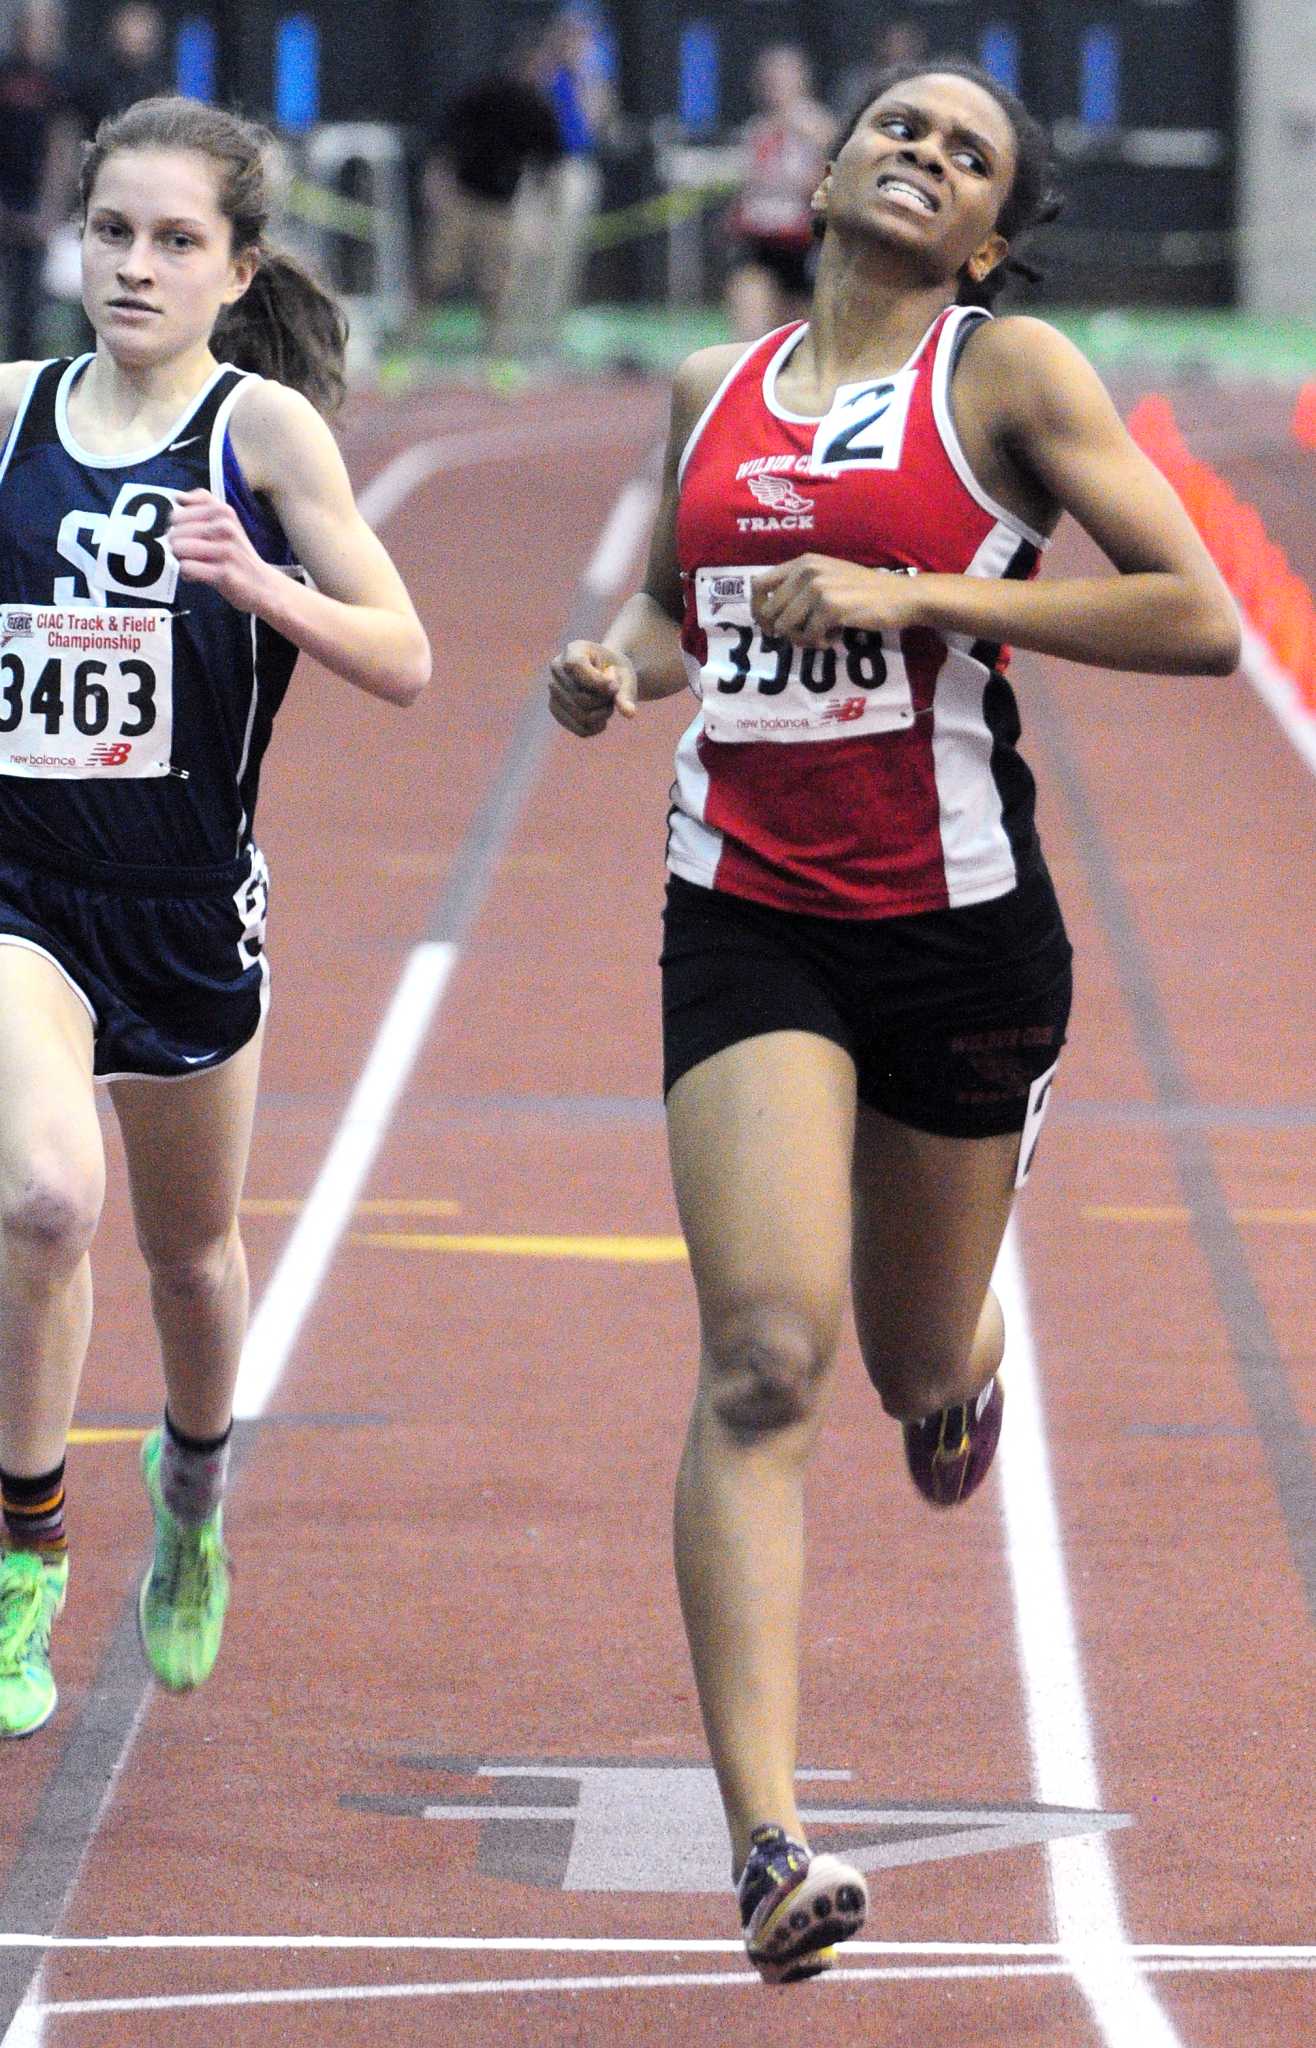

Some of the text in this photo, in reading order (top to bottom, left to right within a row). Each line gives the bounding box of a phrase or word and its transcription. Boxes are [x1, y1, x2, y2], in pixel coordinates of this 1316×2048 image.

[821, 383, 895, 464] 2
[736, 455, 796, 481] WILBUR
[737, 514, 815, 532] TRACK
[107, 492, 174, 588] 3
[36, 613, 156, 633] CIAC Track & Field
[47, 631, 141, 653] Championship
[0, 652, 156, 737] 3463
[736, 717, 809, 730] new balance
[10, 751, 76, 766] new balance
